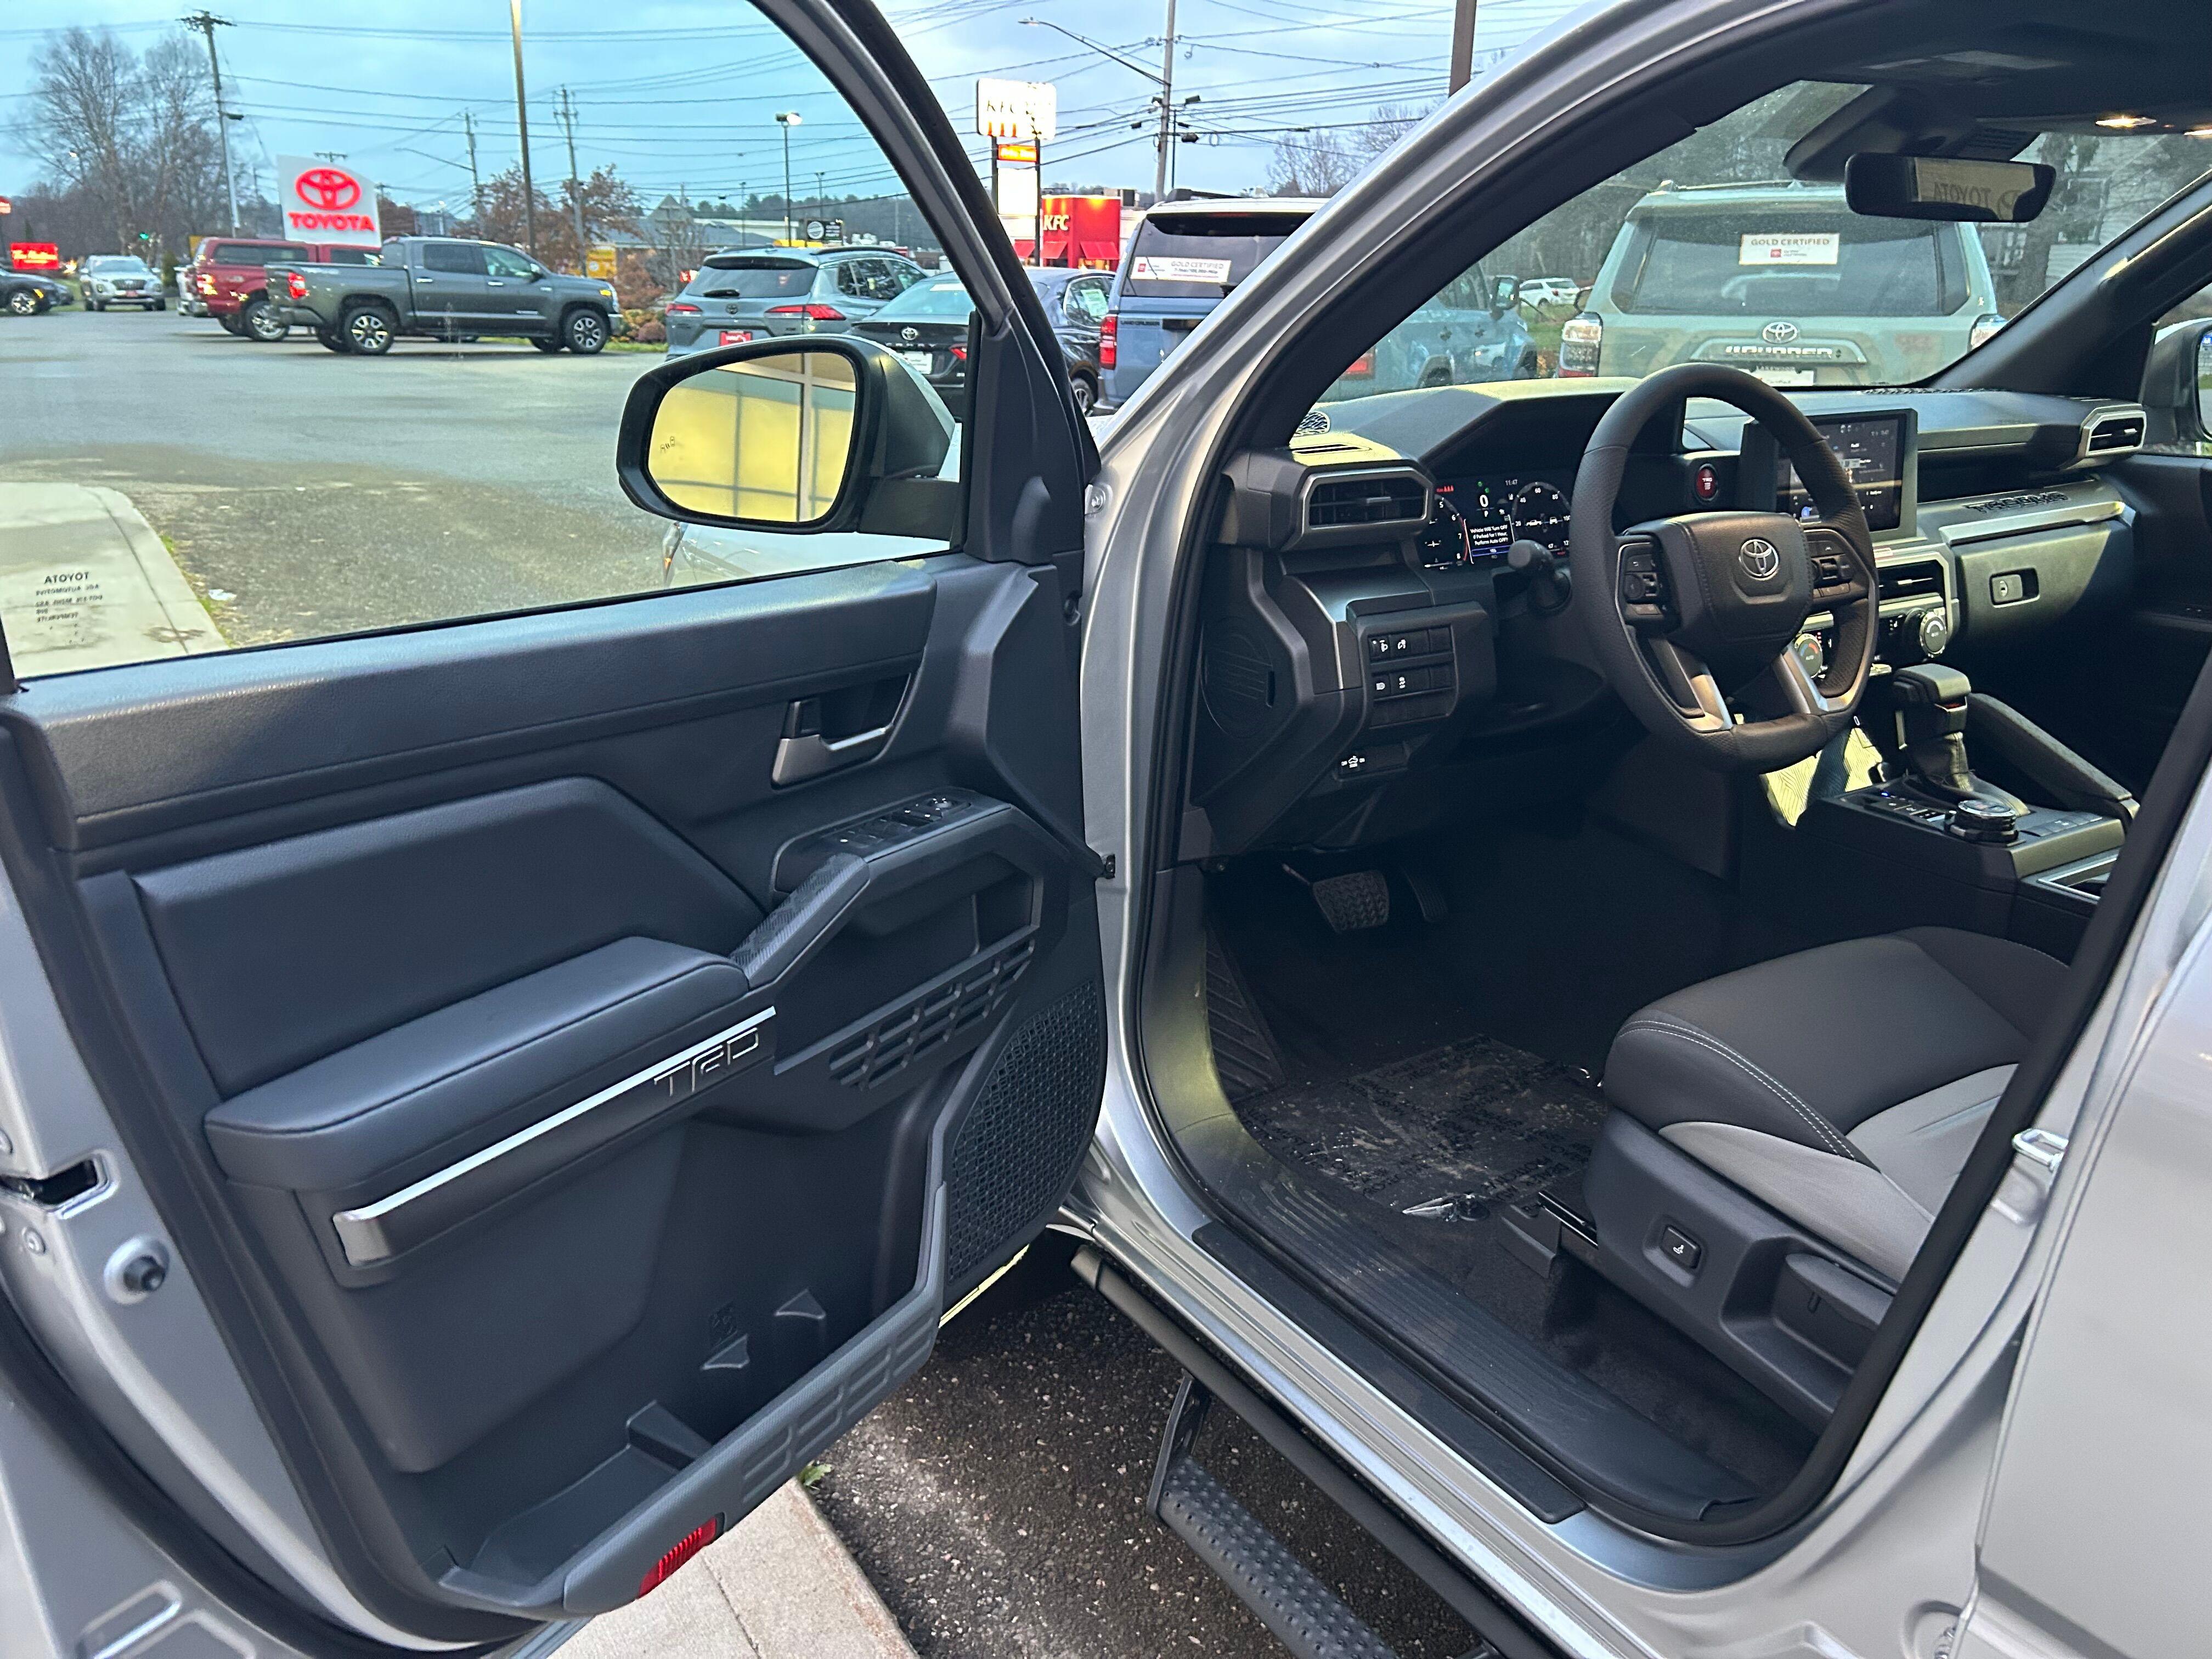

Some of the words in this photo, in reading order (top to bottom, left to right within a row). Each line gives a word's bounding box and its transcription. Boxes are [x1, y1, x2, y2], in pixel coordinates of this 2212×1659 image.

[288, 212, 375, 231] TOYOTA
[1042, 215, 1070, 231] KFC
[1479, 494, 1489, 507] 0
[653, 1026, 759, 1097] TRD
